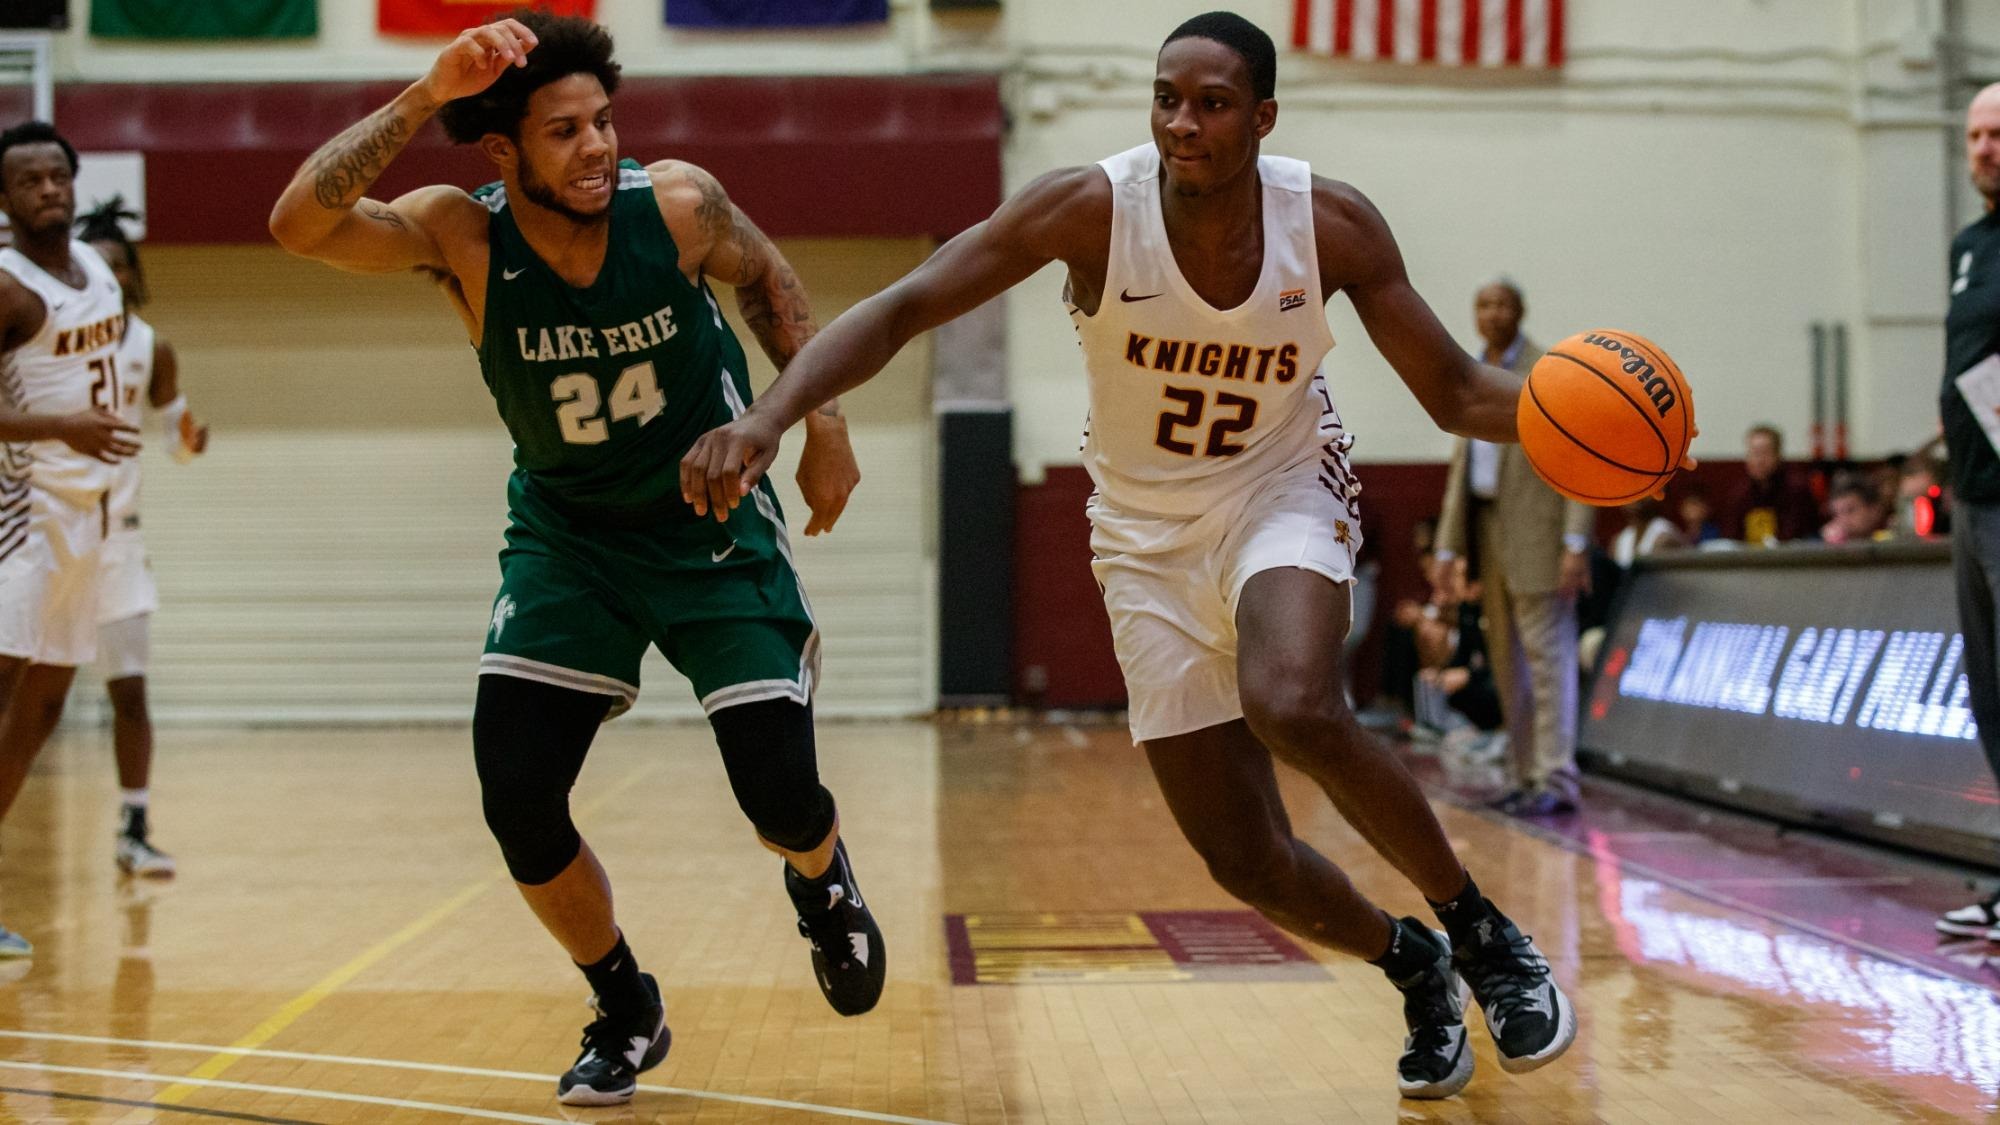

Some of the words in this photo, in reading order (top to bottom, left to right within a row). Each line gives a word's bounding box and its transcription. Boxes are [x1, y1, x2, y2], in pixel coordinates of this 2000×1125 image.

[1279, 292, 1306, 307] PSAC
[517, 325, 600, 362] LAKE
[600, 305, 679, 356] ERIE
[1124, 331, 1299, 384] KNIGHTS
[87, 354, 118, 413] 21
[551, 360, 667, 445] 24
[1583, 333, 1676, 419] Wilson
[1155, 384, 1258, 458] 22
[1774, 626, 1885, 725] GARY
